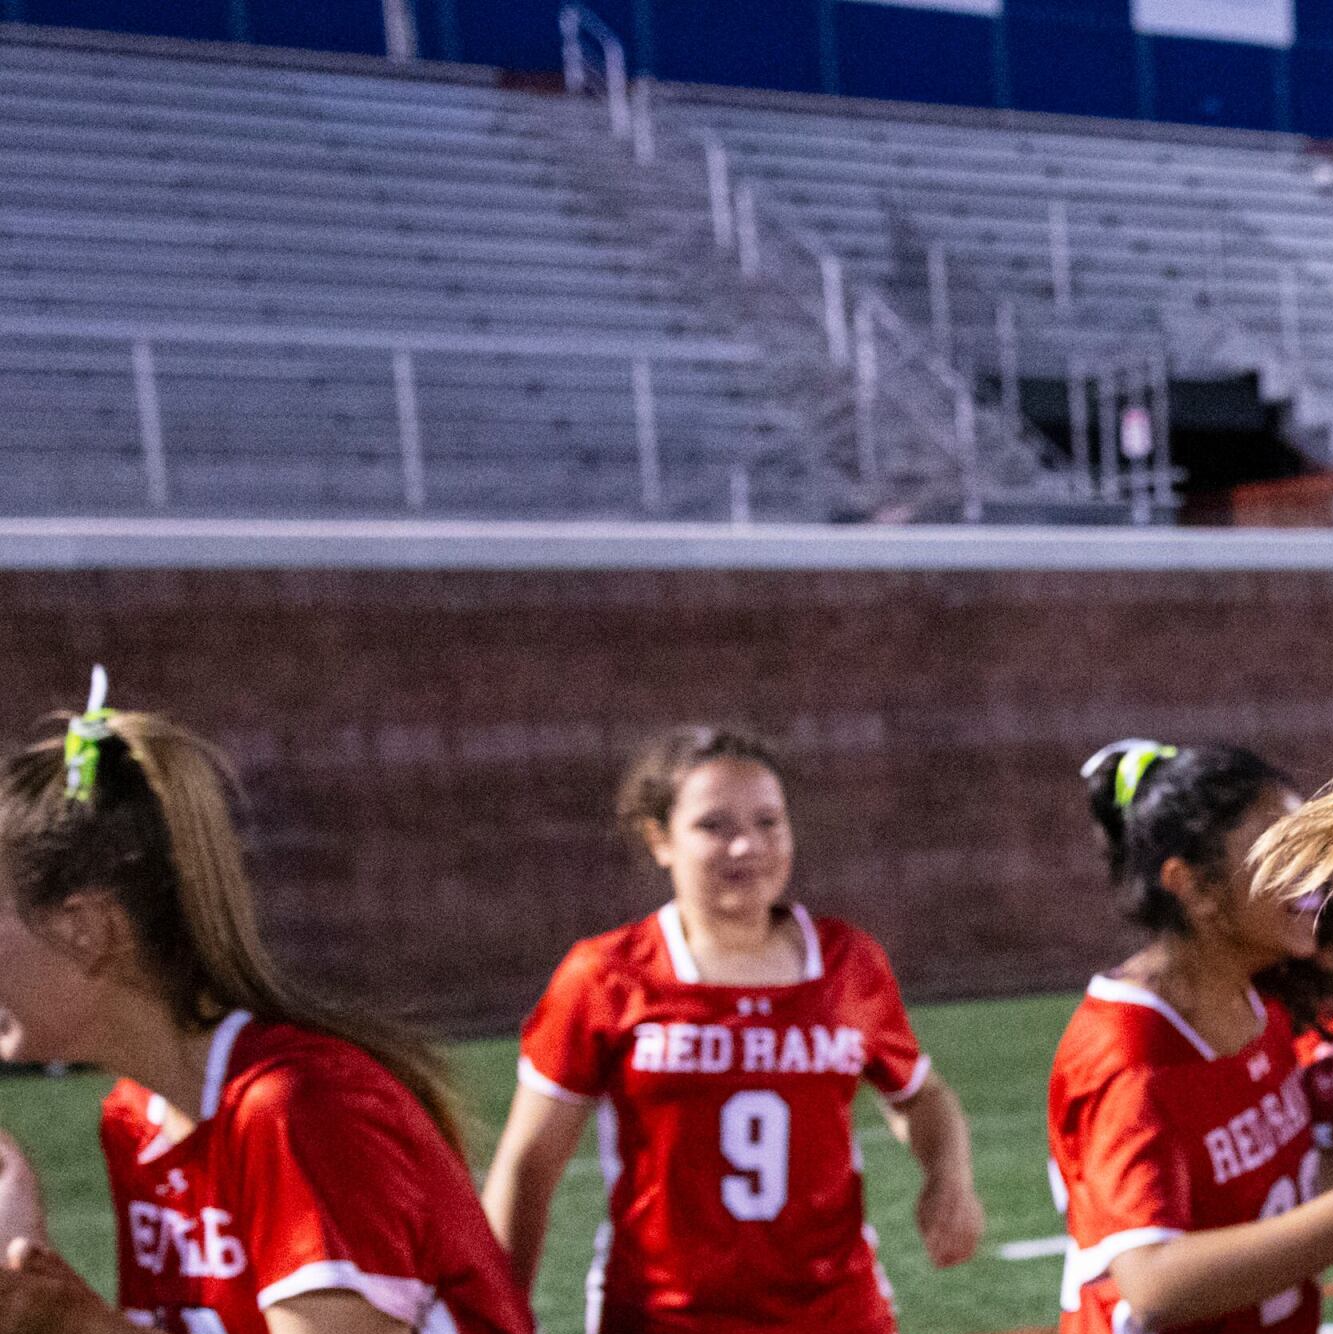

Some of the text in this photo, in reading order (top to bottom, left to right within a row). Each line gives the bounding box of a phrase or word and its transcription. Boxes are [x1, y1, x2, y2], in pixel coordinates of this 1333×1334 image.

[632, 1022, 866, 1076] RED RAMS
[719, 1089, 790, 1222] 9
